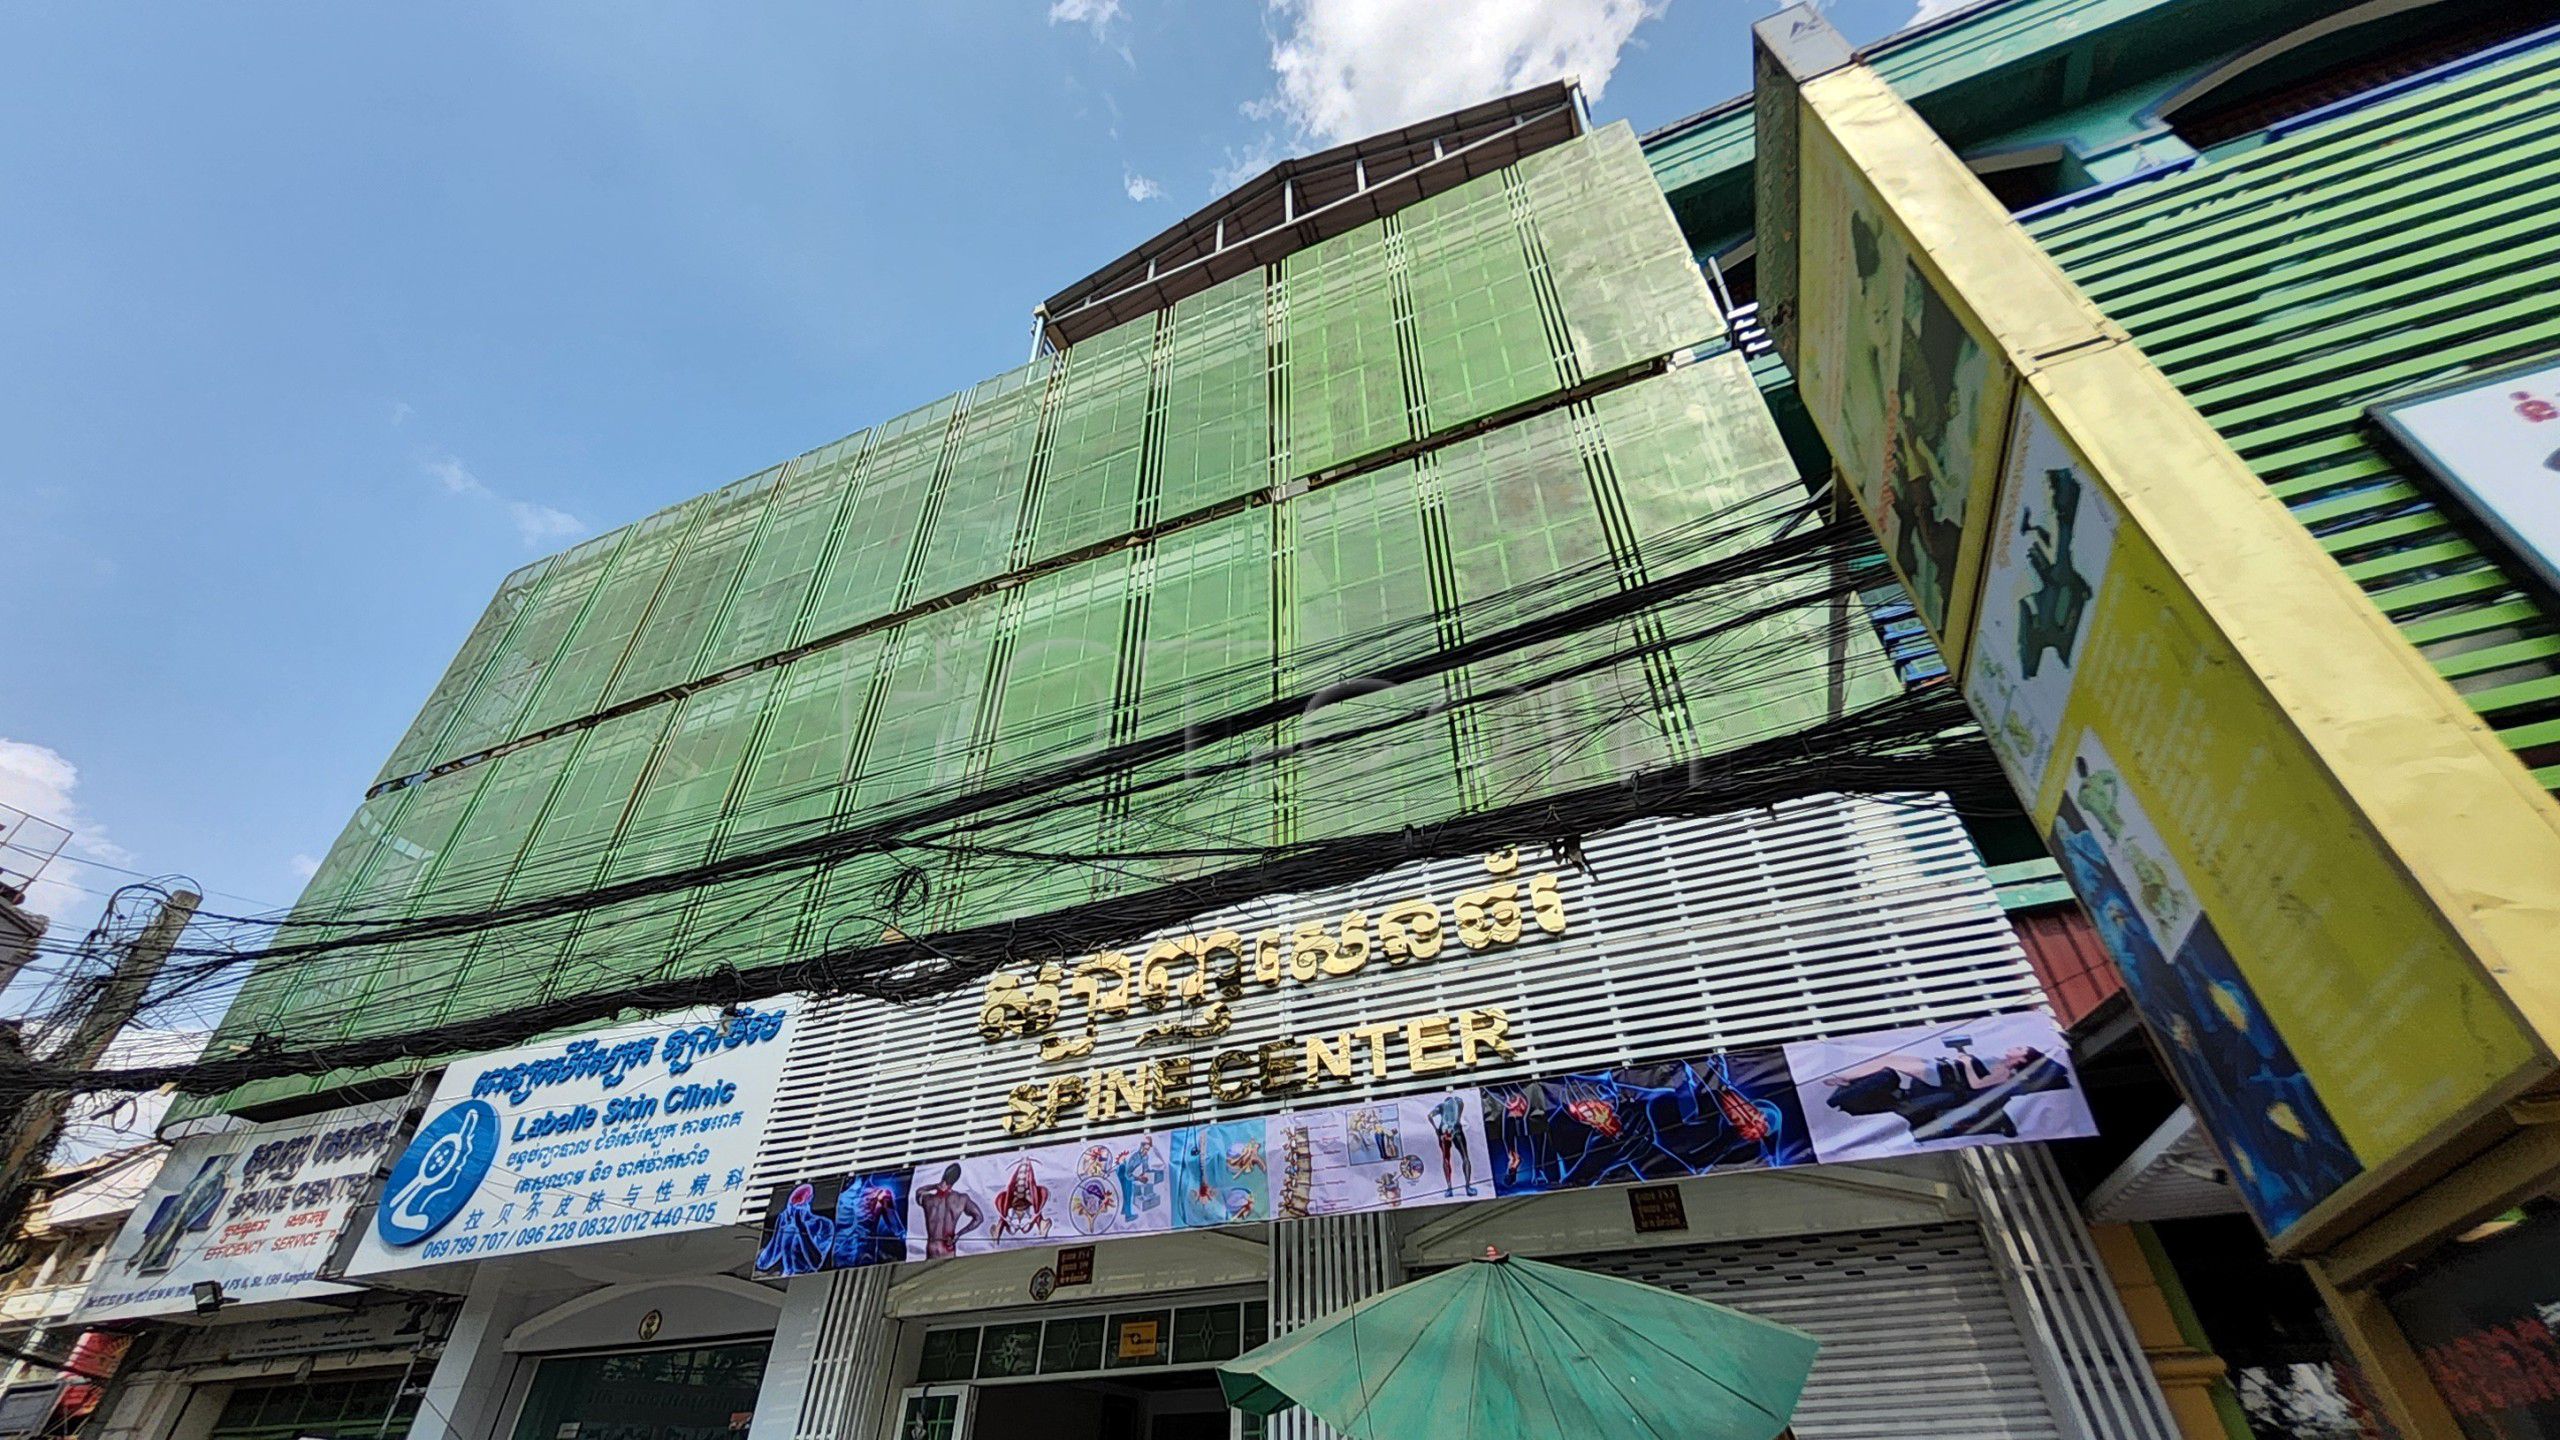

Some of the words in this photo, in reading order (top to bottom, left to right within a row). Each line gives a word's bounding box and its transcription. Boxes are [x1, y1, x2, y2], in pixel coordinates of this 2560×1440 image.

[1002, 1056, 1192, 1136] SPINE
[1208, 1006, 1517, 1103] CENTER
[512, 1105, 597, 1143] Labelle
[602, 1093, 657, 1126] Skin
[664, 1079, 737, 1113] Clinic
[228, 1185, 295, 1219] SPINE
[293, 1173, 371, 1209] CENTE
[203, 1238, 266, 1261] EFFICIENCY
[271, 1232, 320, 1252] SERVICE
[422, 1239, 450, 1259] 069
[449, 1235, 477, 1255] 799
[478, 1232, 508, 1252] 707
[516, 1226, 546, 1246] 096
[546, 1221, 576, 1242] 228
[651, 1207, 683, 1228] 440
[685, 1202, 717, 1224] 705
